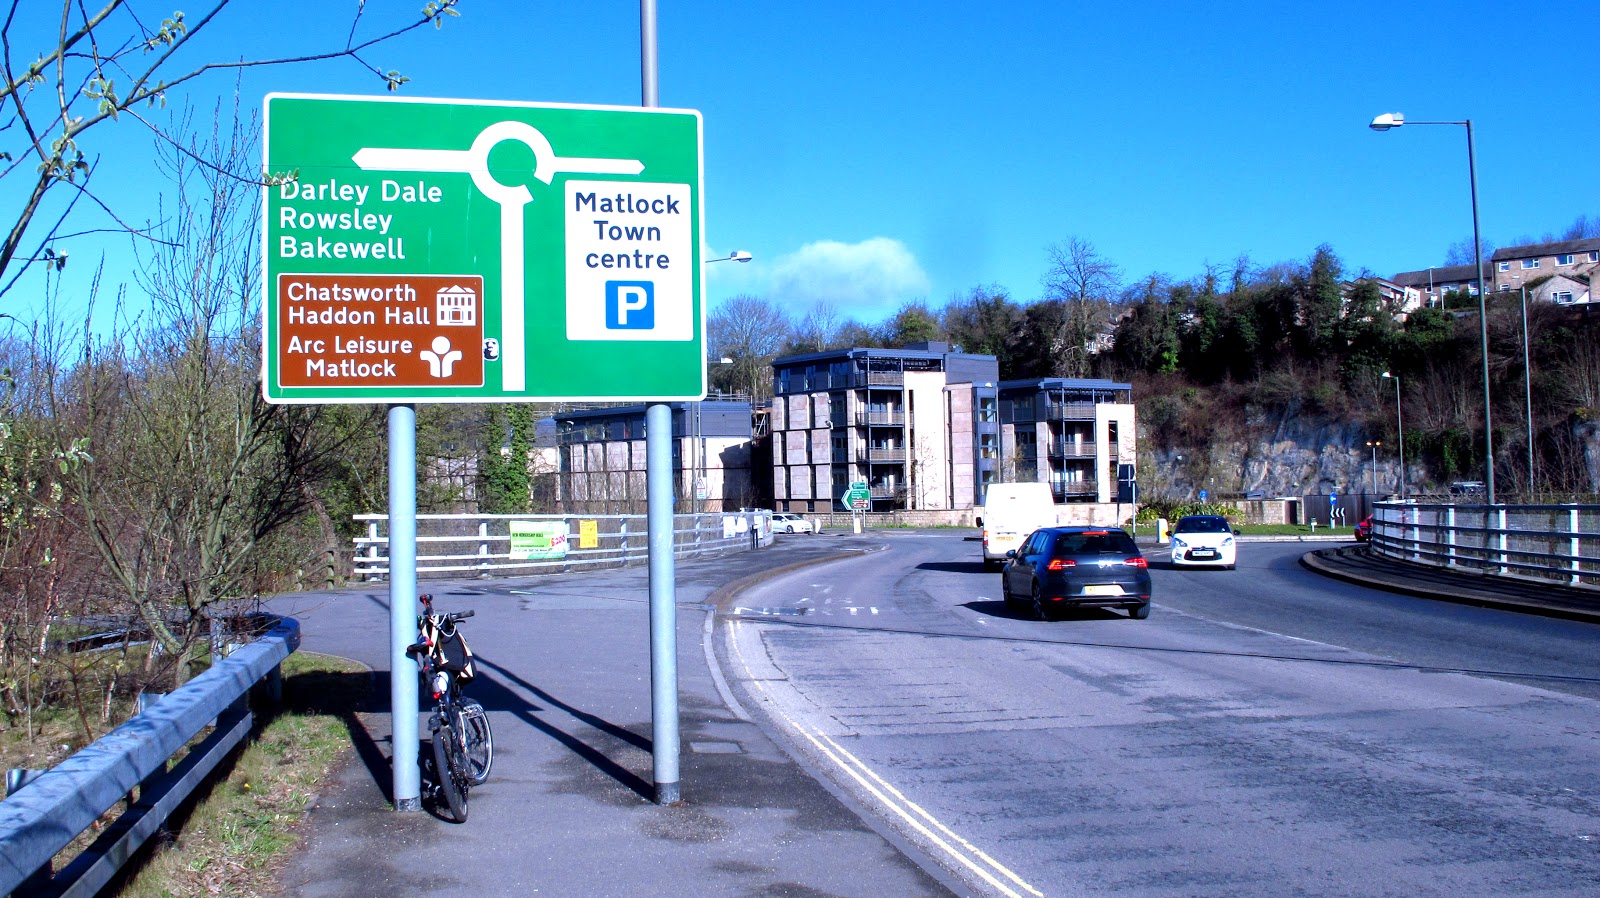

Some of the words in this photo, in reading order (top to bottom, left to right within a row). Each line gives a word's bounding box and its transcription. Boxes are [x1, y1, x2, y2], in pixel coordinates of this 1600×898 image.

[280, 178, 370, 206] Darley
[381, 180, 443, 203] Dale
[575, 191, 680, 215] Matlock
[280, 206, 393, 235] Rowsley
[593, 219, 661, 242] Town
[280, 235, 406, 260] Bakewell
[585, 248, 670, 270] centre
[287, 281, 417, 302] Chatsworth
[288, 305, 375, 325] Haddon
[385, 306, 431, 325] Hall
[617, 285, 648, 325] P
[287, 335, 326, 354] Arc
[334, 335, 413, 354] Leisure
[306, 358, 397, 378] Matlock
